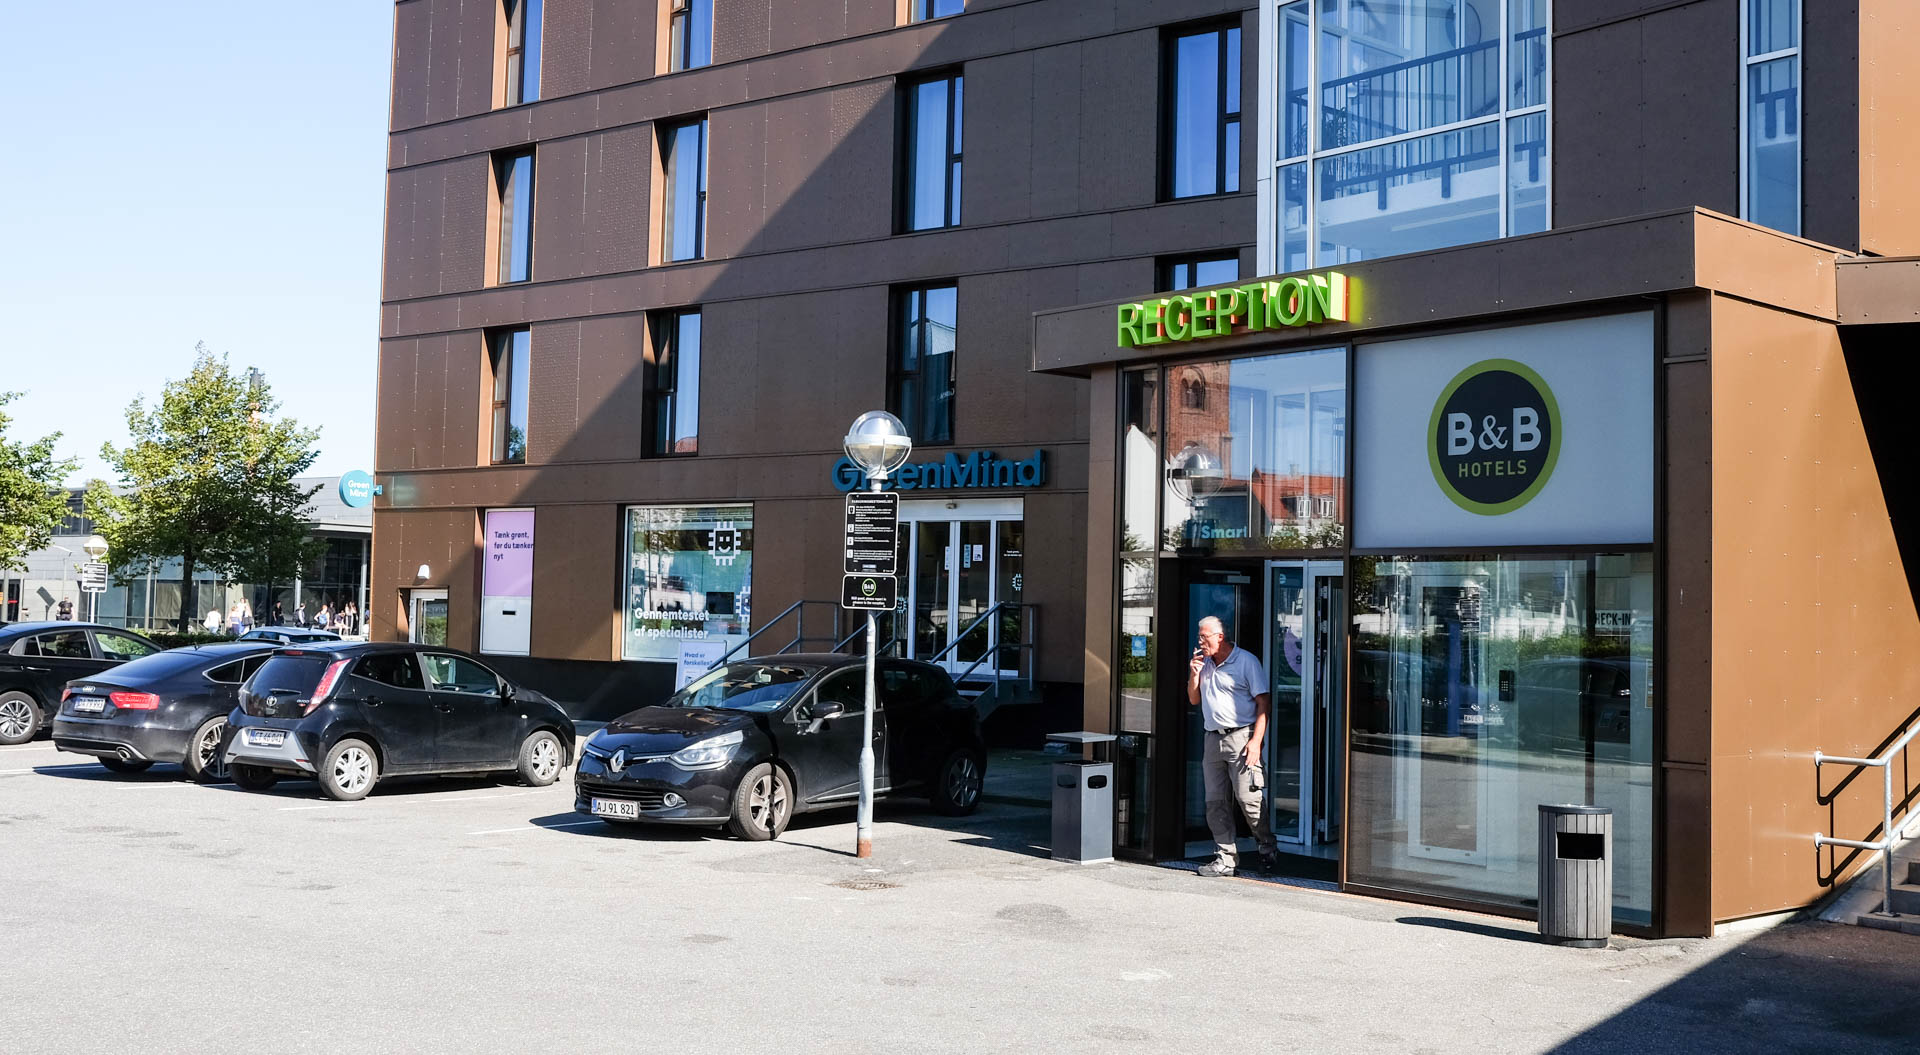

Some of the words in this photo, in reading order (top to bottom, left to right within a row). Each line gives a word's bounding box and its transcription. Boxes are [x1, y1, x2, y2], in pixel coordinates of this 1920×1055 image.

[1117, 271, 1348, 348] RECEPTION
[1447, 407, 1542, 456] B&B
[1458, 460, 1527, 478] HOTELS
[348, 480, 370, 489] Green
[349, 488, 368, 498] Mind
[634, 608, 709, 621] Gennemtestet
[1594, 612, 1631, 626] HECK-IN
[634, 626, 645, 638] af
[646, 627, 709, 640] specialister
[597, 802, 607, 812] AJ
[608, 803, 617, 813] 91
[620, 804, 634, 815] 821
